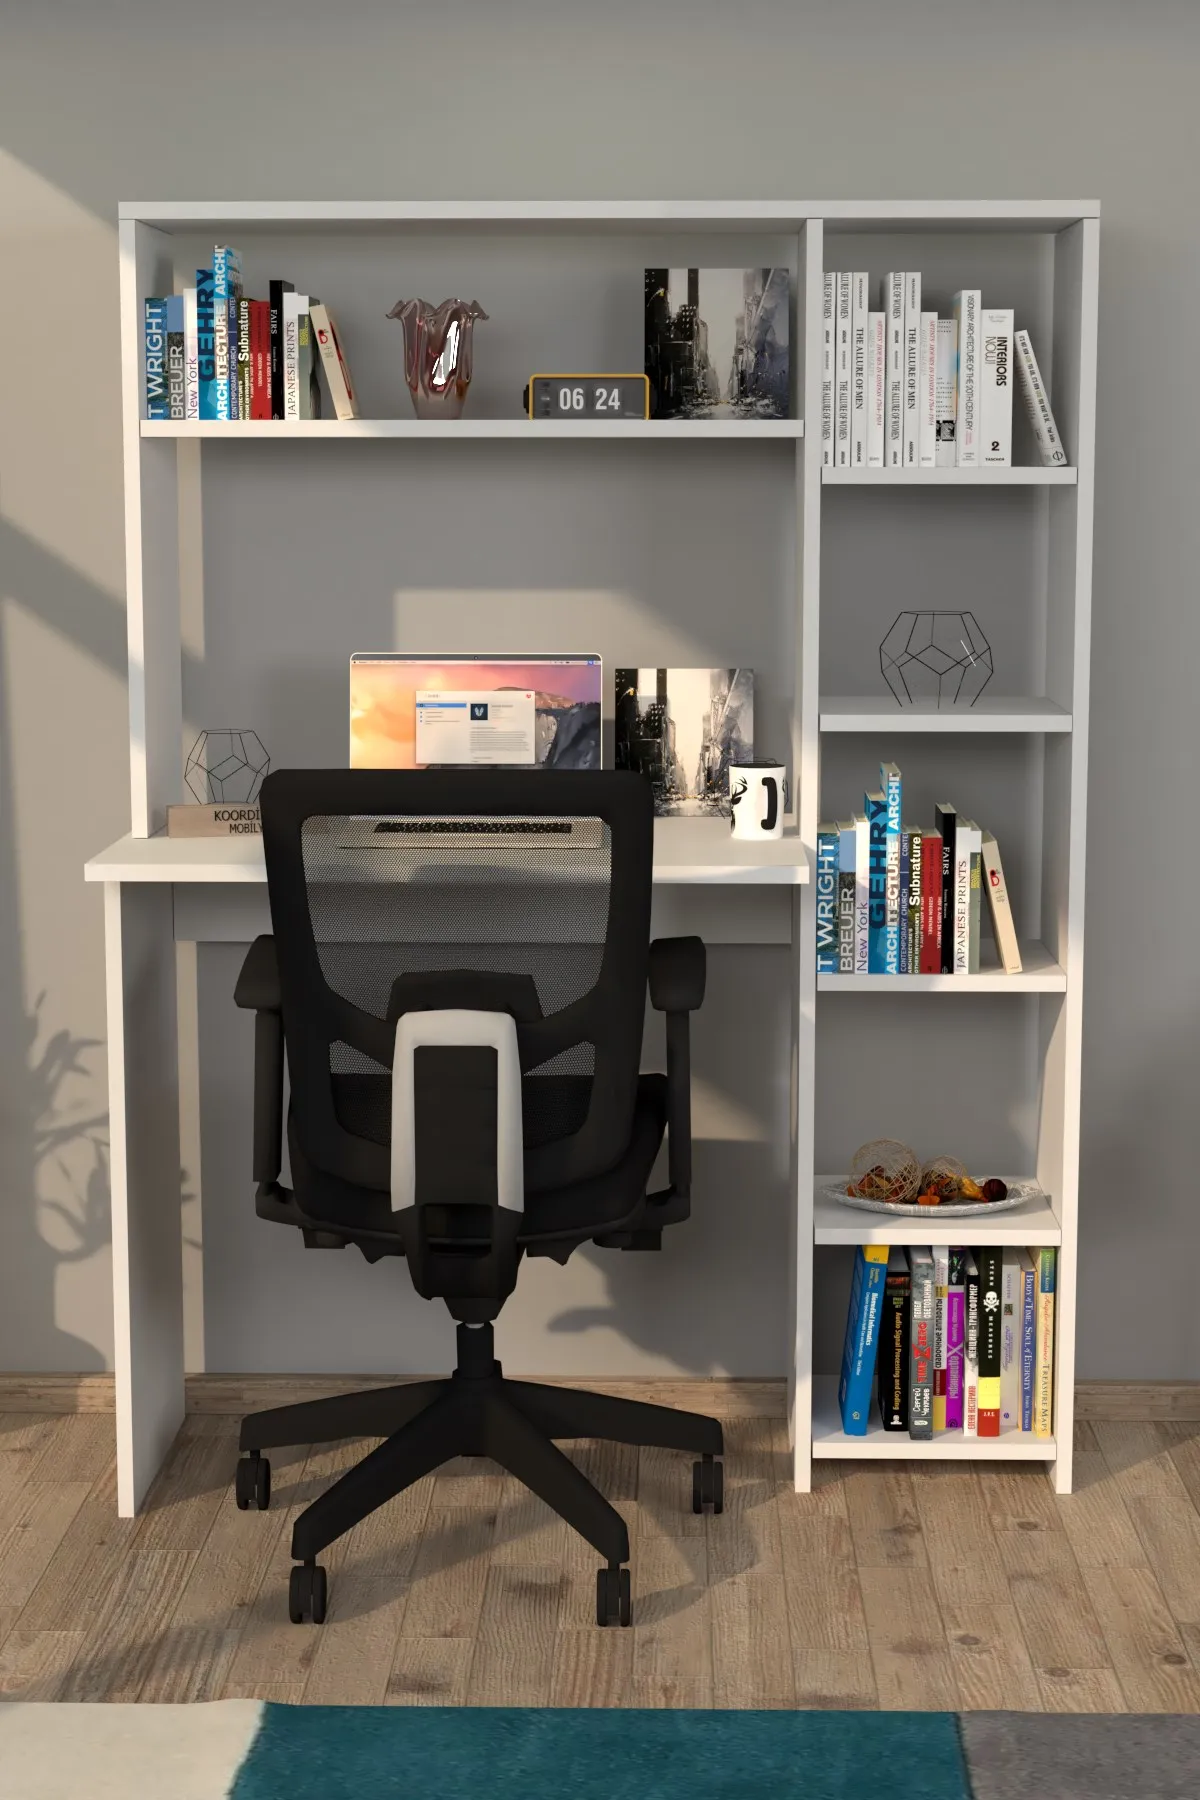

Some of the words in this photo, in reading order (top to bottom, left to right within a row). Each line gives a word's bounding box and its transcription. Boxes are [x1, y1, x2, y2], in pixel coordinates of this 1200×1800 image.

[197, 269, 214, 381] GEHRY
[238, 300, 249, 361] Subnature
[270, 309, 278, 335] FAIRS
[856, 328, 864, 345] THE
[907, 328, 916, 345] THE
[146, 303, 163, 396] WRIGHT
[286, 321, 295, 360] PRINTS
[966, 322, 974, 364] ARCHITECTURE
[215, 305, 228, 420] ARCHITECTURE
[229, 346, 237, 370] CHURCH
[856, 346, 864, 377] ALLURE
[907, 346, 916, 377] ALLURE
[996, 336, 1008, 386] INTERIORS
[170, 346, 184, 419] BREUER
[186, 357, 198, 390] York
[856, 378, 864, 389] OF
[907, 378, 916, 389] OF
[230, 371, 238, 419] CONTEMPORARY
[287, 363, 297, 416] JAPANESE
[560, 388, 584, 410] 06
[595, 388, 620, 410] 24
[822, 392, 831, 412] ALLURE
[839, 392, 848, 412] ALLURE
[856, 391, 864, 410] MEN
[891, 392, 900, 412] ALLURE
[907, 391, 916, 410] MEN
[187, 393, 198, 419] New
[991, 440, 1000, 451] 2
[214, 807, 260, 821] KOORDİ
[869, 800, 887, 929] GEHRY
[909, 836, 921, 906] Subnature
[942, 846, 950, 876] FAIRS
[817, 839, 835, 948] WRIGHT
[958, 860, 967, 904] PRINTS
[886, 840, 899, 974] ARCHITECTURE
[901, 888, 909, 916] CHURCH
[840, 888, 854, 972] BREUER
[857, 902, 868, 934] York
[956, 908, 967, 968] JAPANESE
[857, 941, 868, 972] New
[1026, 1274, 1034, 1296] BODY
[869, 1292, 879, 1319] Biomedical
[894, 1311, 903, 1328] Audio
[935, 1298, 943, 1332] аппараты
[865, 1319, 876, 1346] Informatics
[894, 1329, 903, 1347] Signal
[1024, 1326, 1033, 1347] SOUL
[893, 1348, 902, 1378] Processing
[1023, 1354, 1033, 1390] ETERNITY
[1041, 1363, 1050, 1406] TREASURE
[892, 1390, 902, 1410] Coding
[913, 1388, 921, 1412] Сергей
[1041, 1408, 1049, 1431] MAPS
